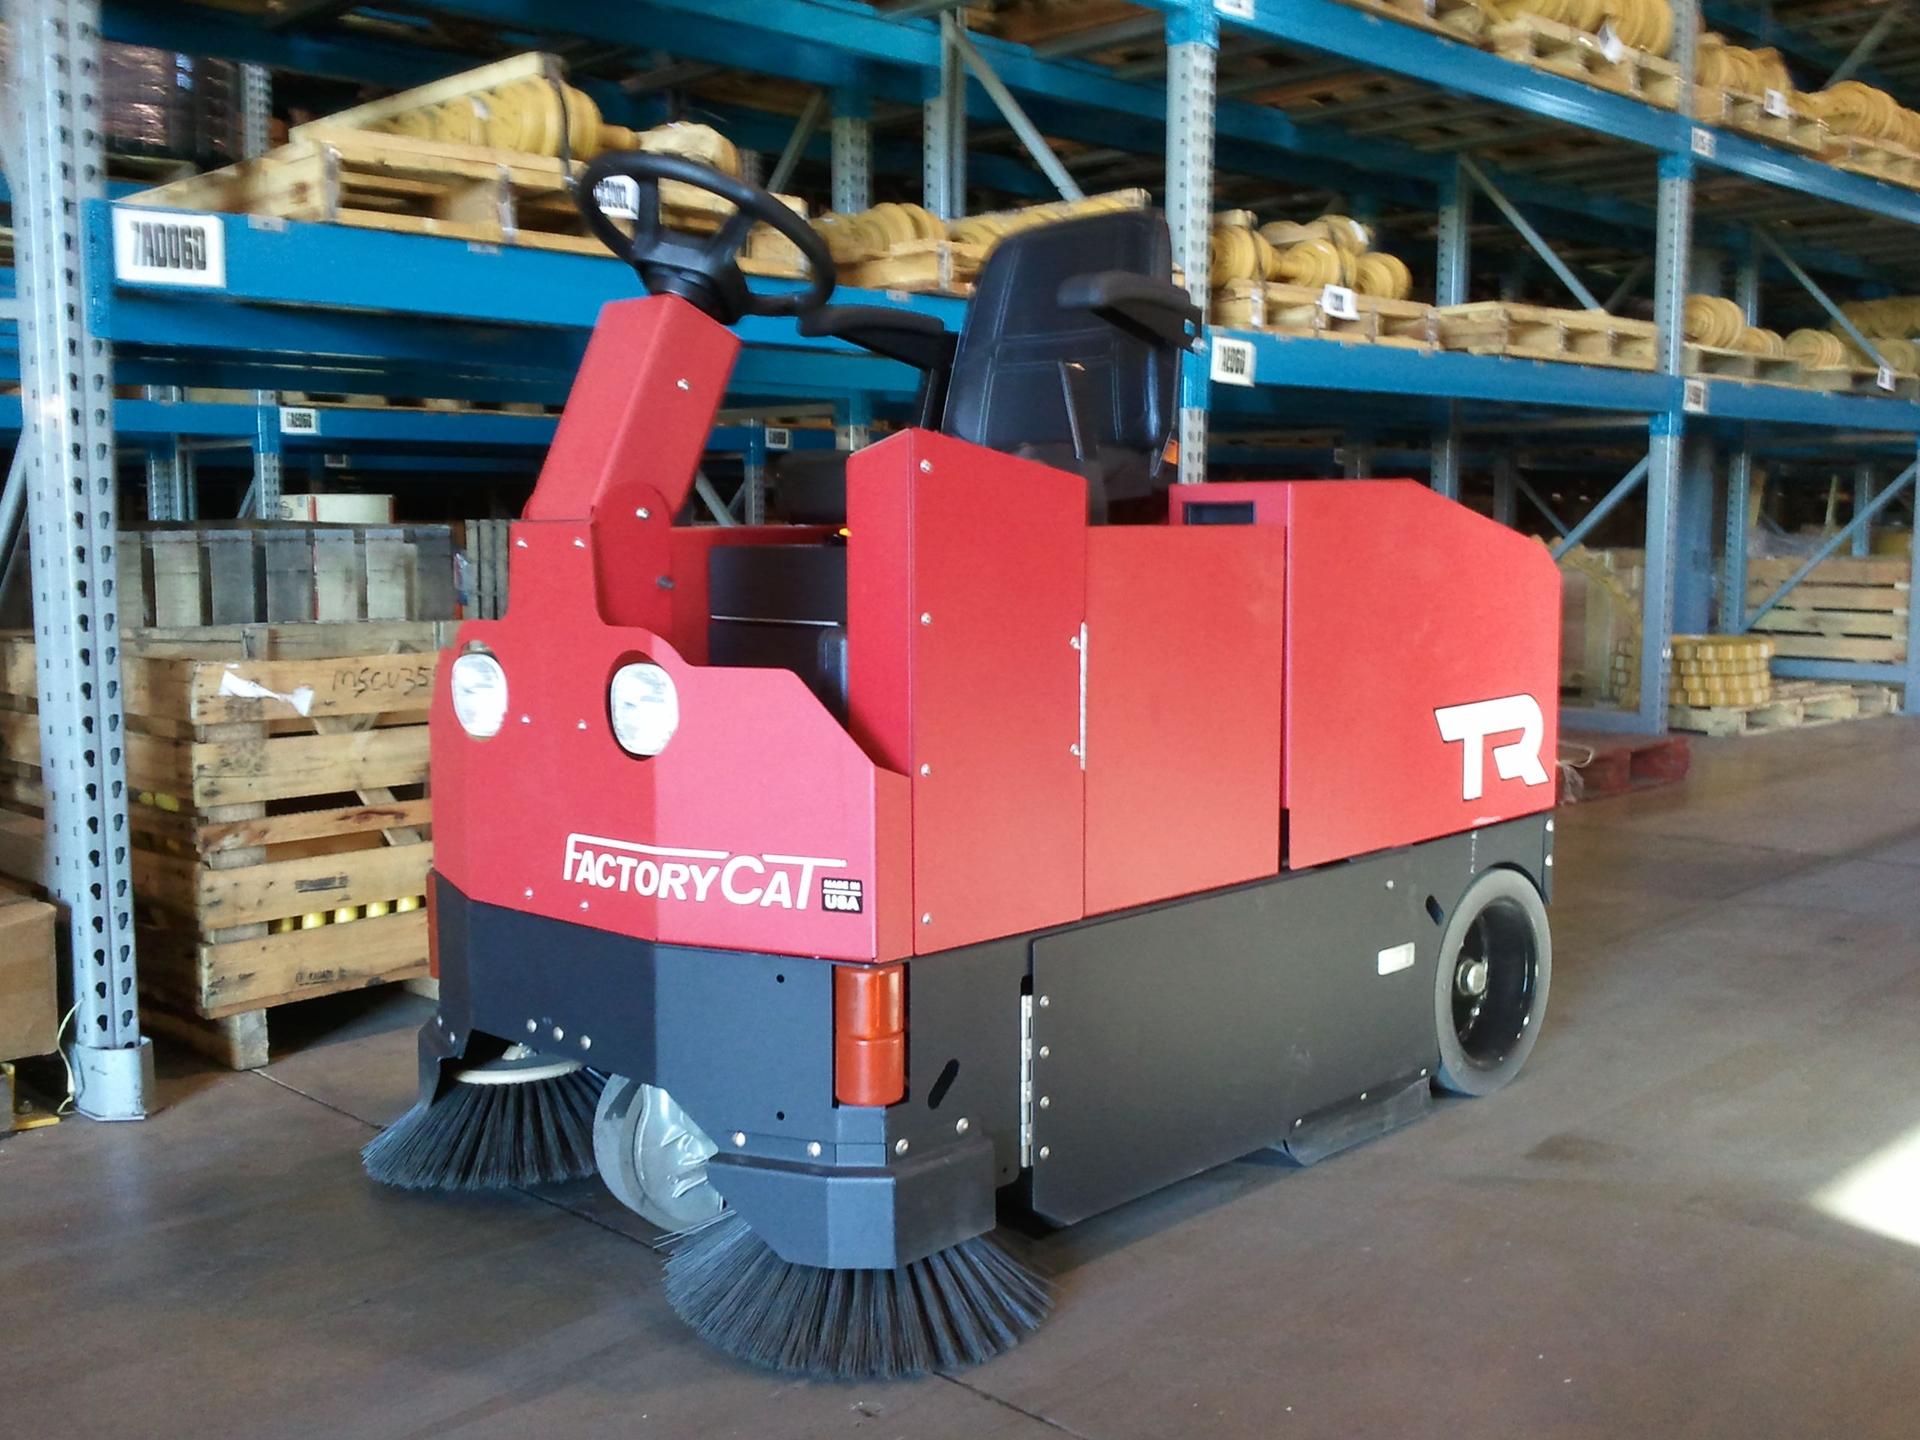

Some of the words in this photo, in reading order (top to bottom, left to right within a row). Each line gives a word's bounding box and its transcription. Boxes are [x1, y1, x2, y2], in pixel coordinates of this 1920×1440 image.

[1433, 692, 1551, 801] TR
[823, 878, 849, 889] MADE
[824, 894, 860, 911] USA
